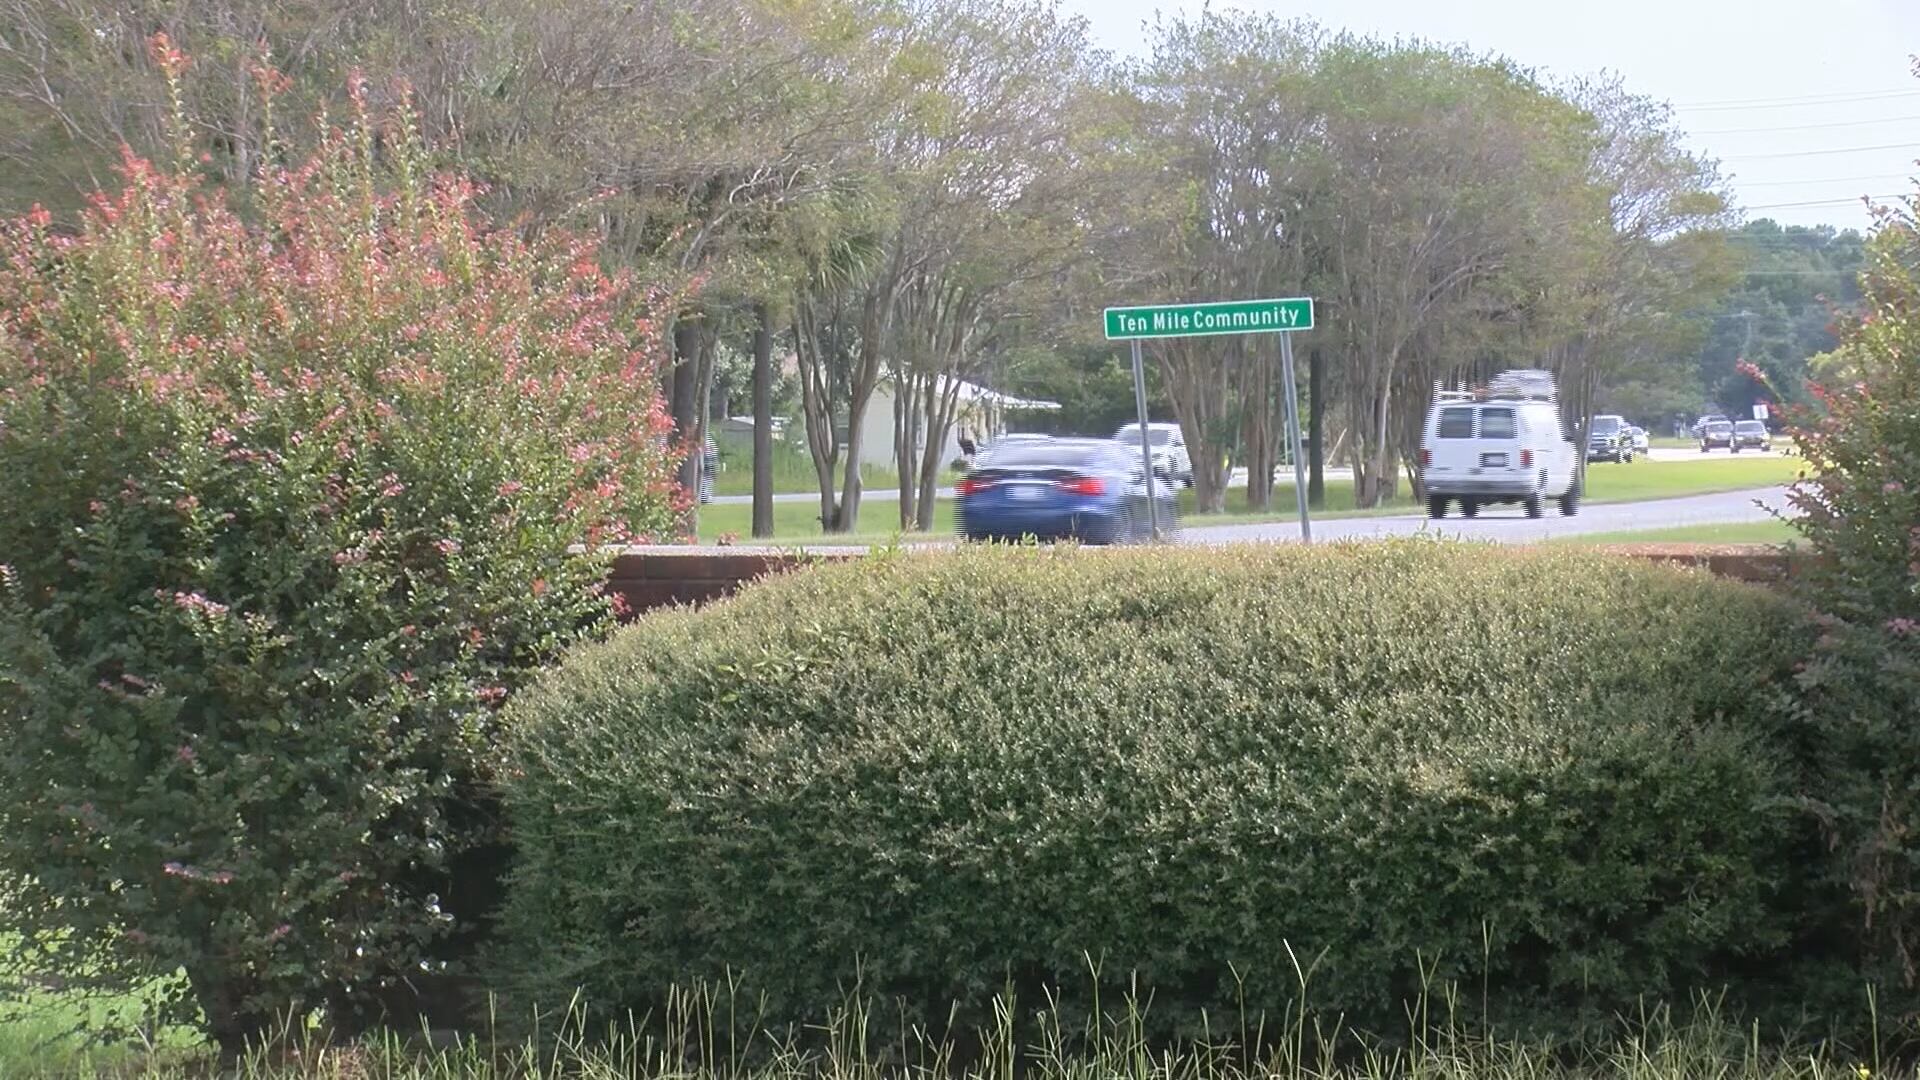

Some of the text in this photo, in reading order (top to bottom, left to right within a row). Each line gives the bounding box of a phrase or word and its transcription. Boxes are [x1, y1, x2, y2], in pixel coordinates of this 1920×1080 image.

[1118, 306, 1299, 332] Ten Mile Community
